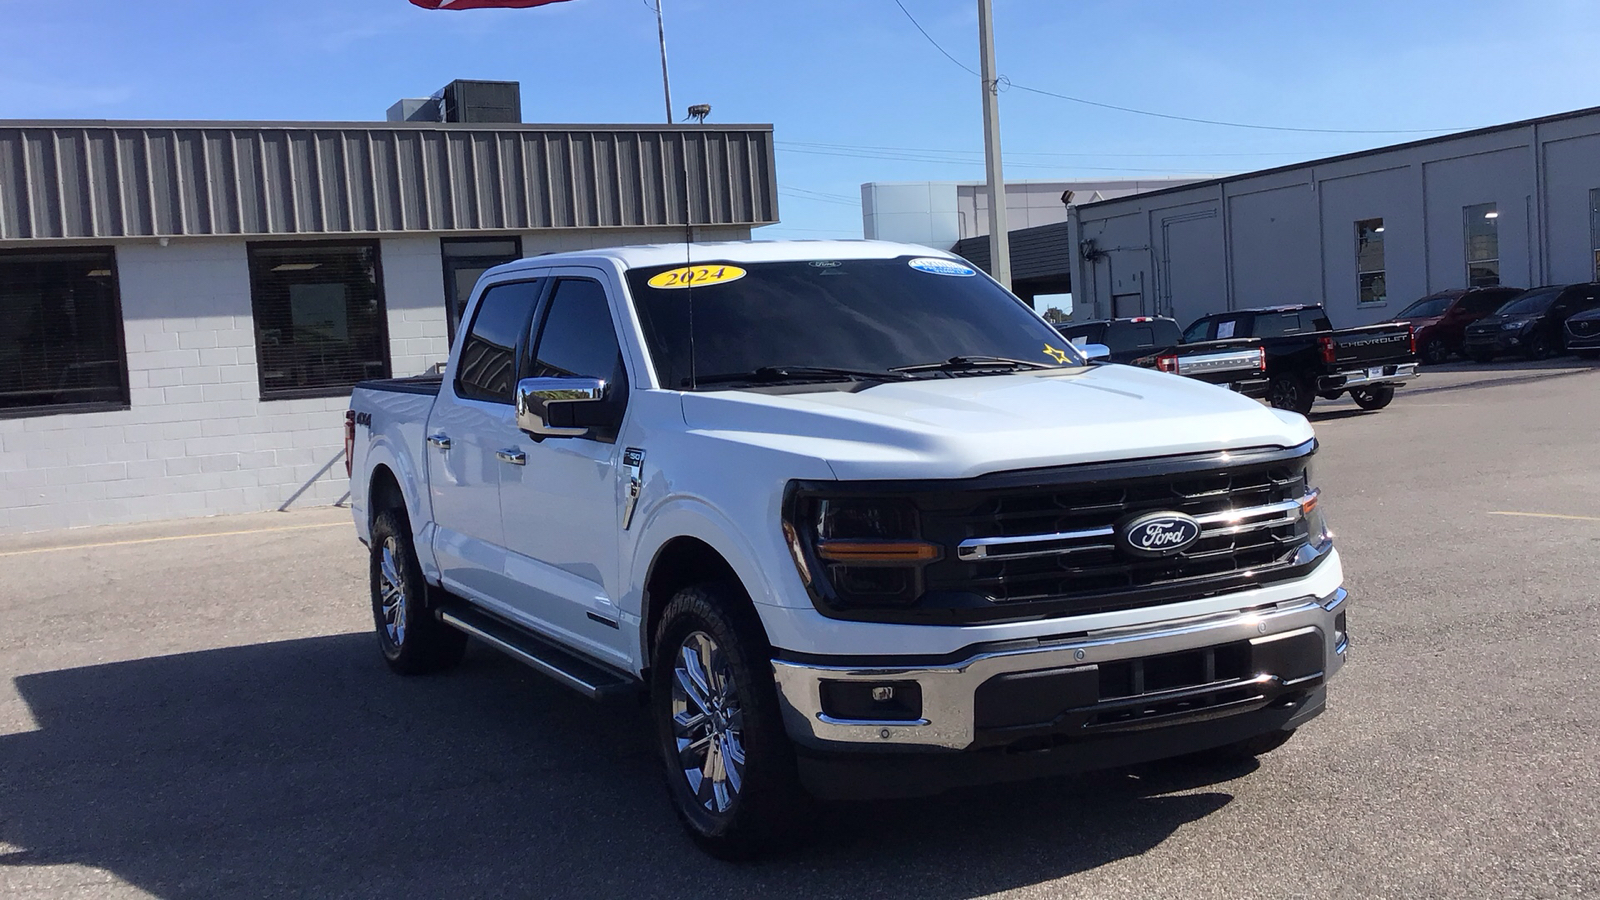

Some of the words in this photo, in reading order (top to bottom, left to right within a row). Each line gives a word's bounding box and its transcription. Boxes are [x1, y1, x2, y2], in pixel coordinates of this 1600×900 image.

[664, 267, 726, 286] 2024
[1340, 335, 1407, 348] CHEVROLET
[1142, 522, 1185, 547] Ford
